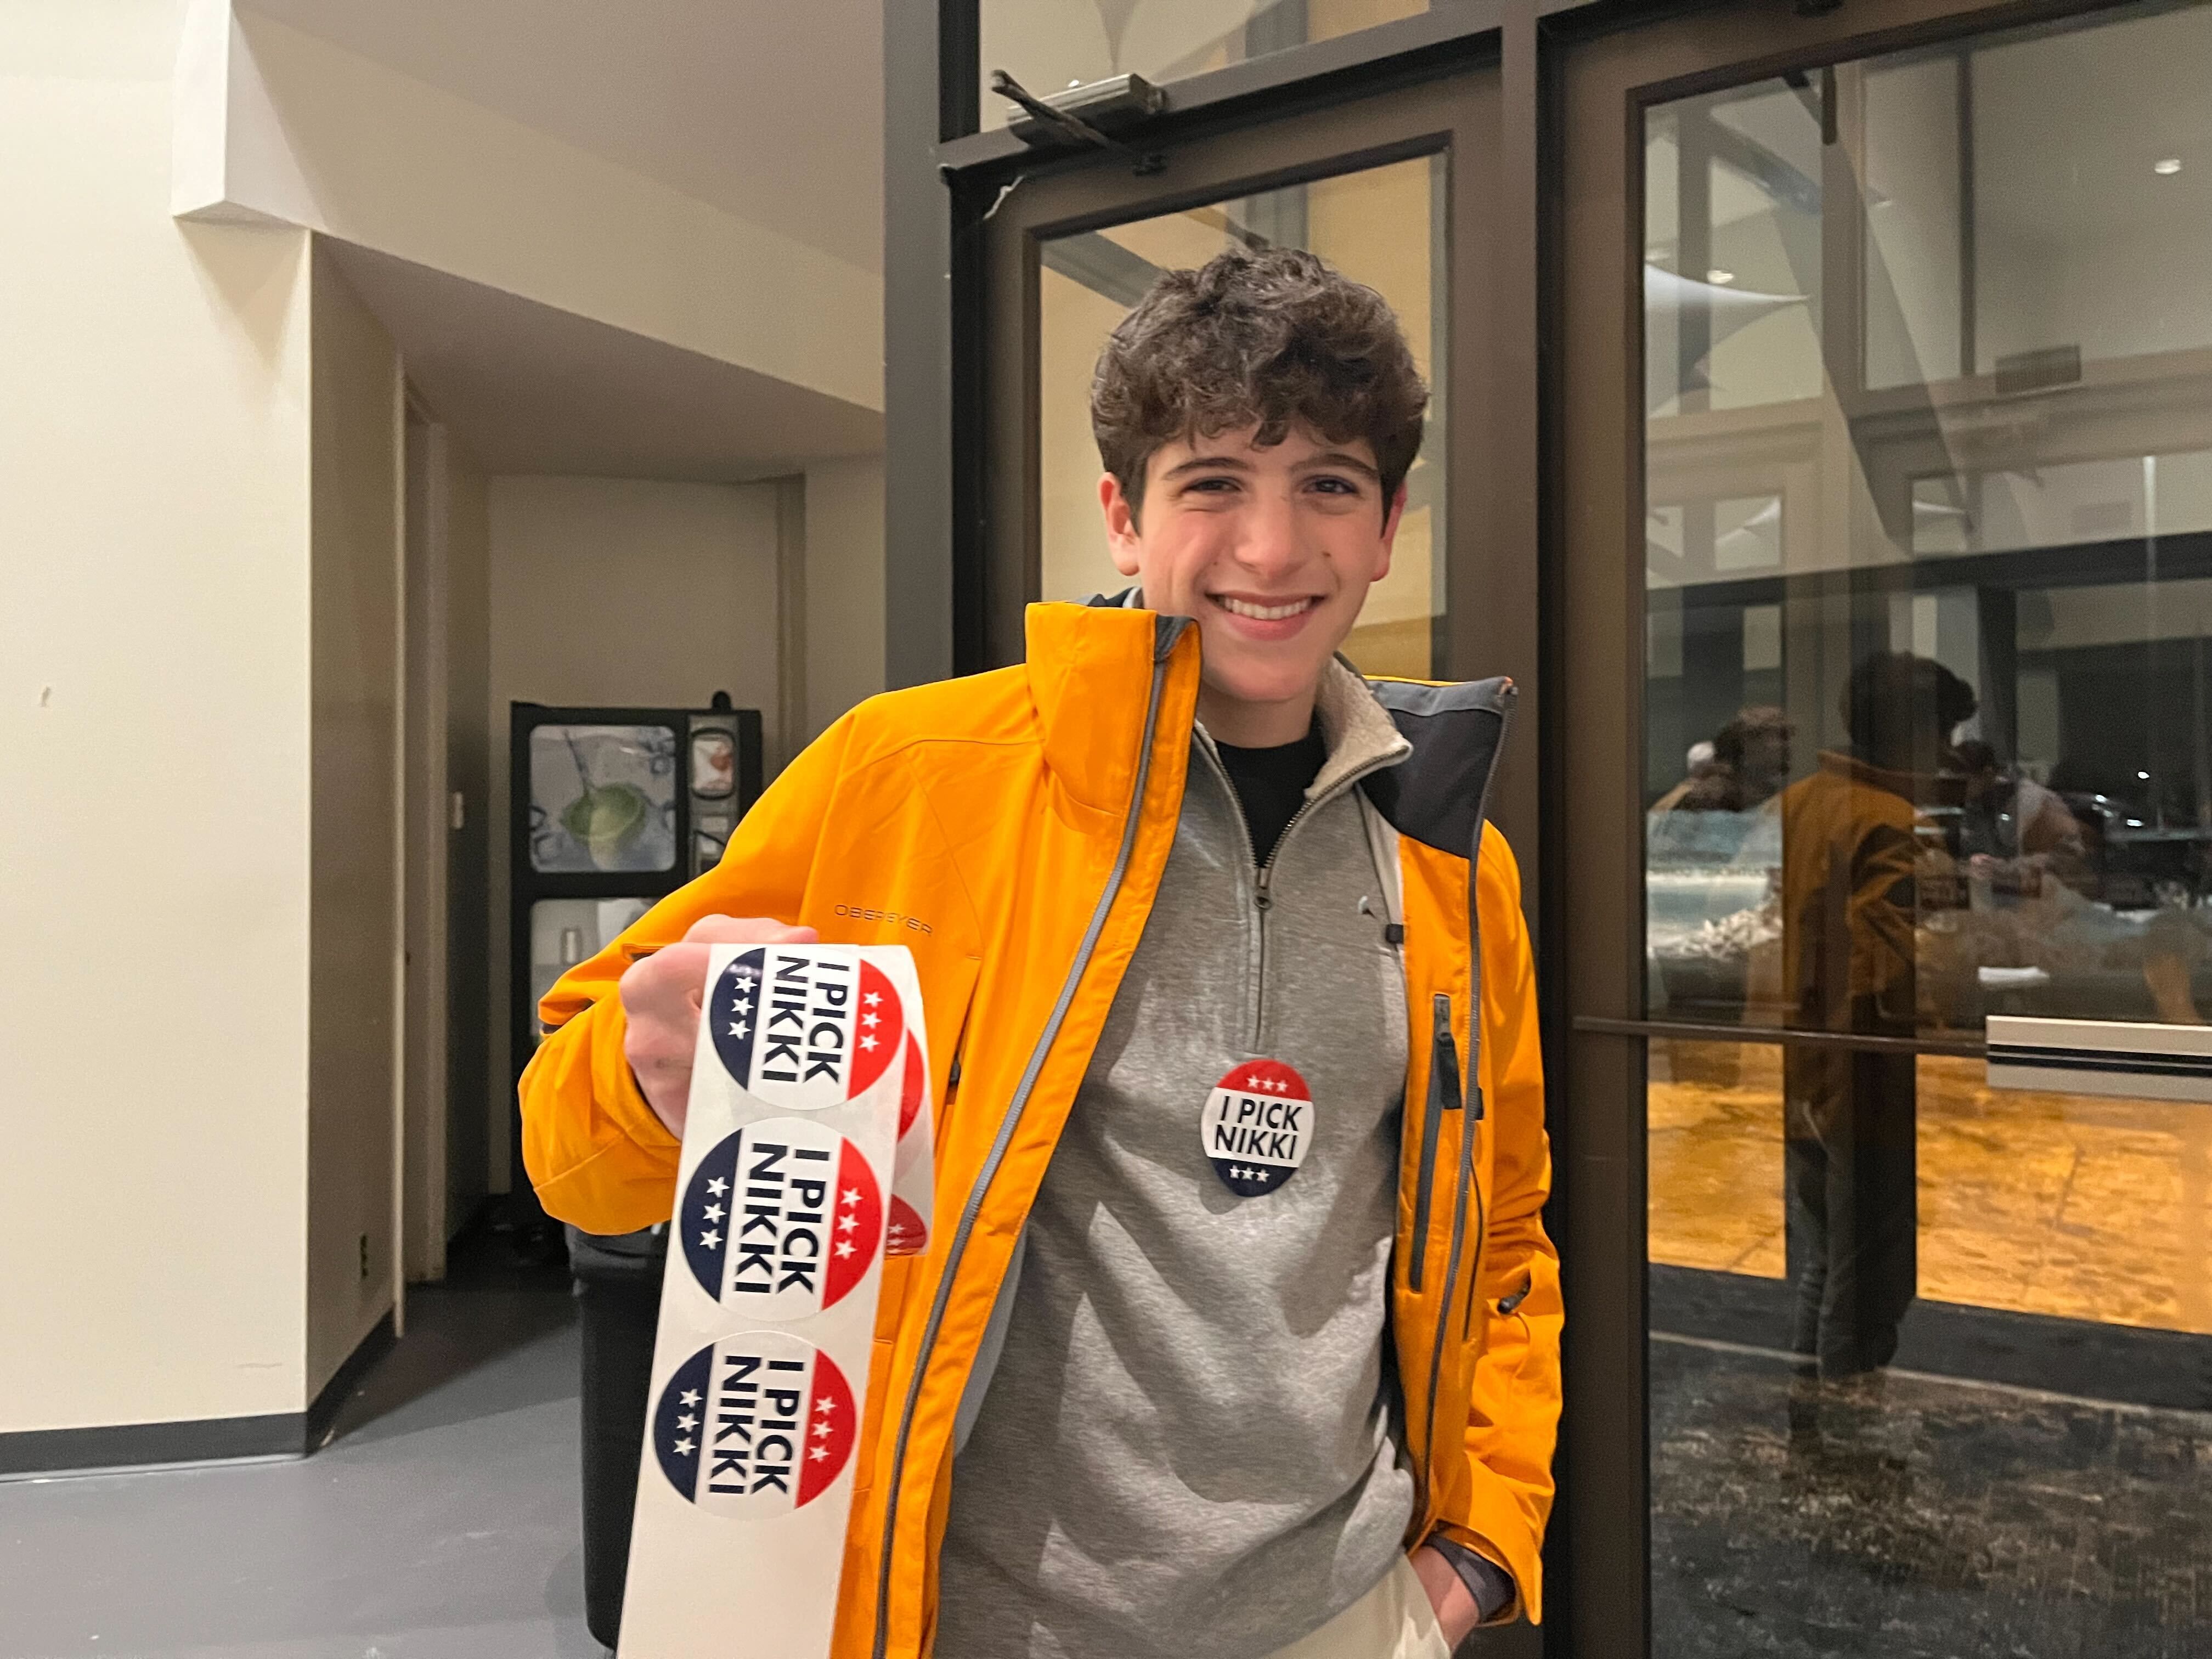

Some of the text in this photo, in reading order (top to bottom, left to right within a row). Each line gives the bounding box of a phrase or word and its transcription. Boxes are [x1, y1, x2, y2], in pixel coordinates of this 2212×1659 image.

[761, 955, 810, 1082] NIKKI
[804, 962, 850, 1084] I PICK
[1215, 1125, 1297, 1159] NIKKI
[1221, 1096, 1302, 1131] I PICK
[735, 1143, 788, 1293] NIKKI
[777, 1149, 830, 1294] I PICK
[709, 1356, 761, 1494] NIKKI
[752, 1361, 804, 1494] I PICK
